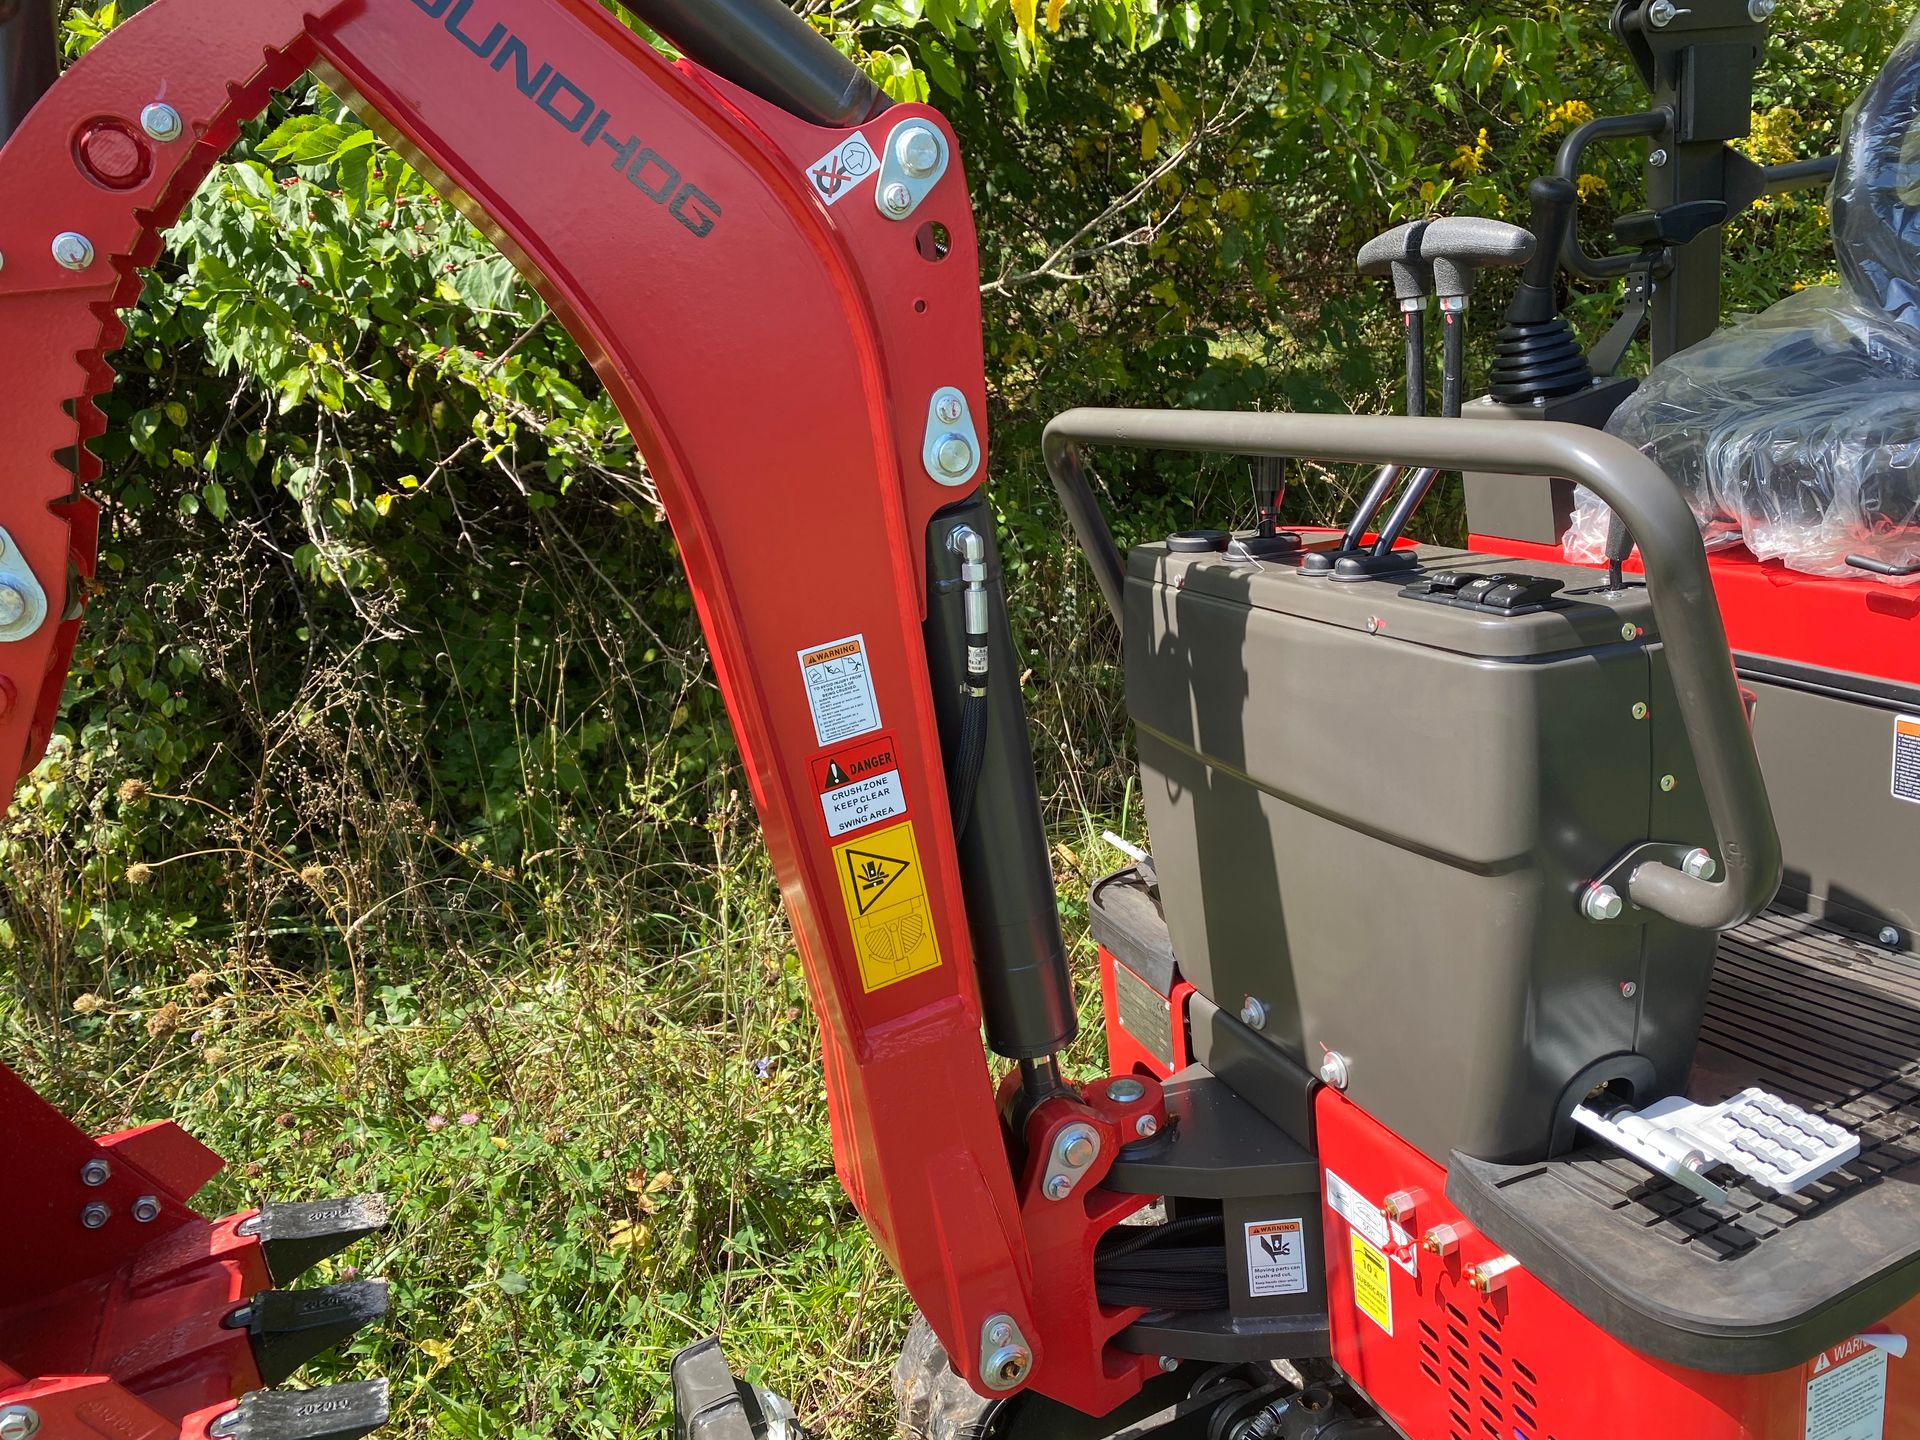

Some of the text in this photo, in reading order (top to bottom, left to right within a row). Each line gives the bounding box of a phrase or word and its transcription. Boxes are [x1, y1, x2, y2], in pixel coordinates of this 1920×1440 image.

[411, 0, 722, 239] UNDHOG
[816, 644, 856, 661] WARNING
[850, 752, 892, 775] DANGER
[832, 777, 888, 801] CRUSH ZONE
[834, 788, 890, 812] KEEP CLEAR
[839, 806, 894, 830] SWING AREA
[856, 805, 869, 814] OF
[1260, 1224, 1295, 1233] WARNING
[1356, 1272, 1387, 1303] LUBRICATE
